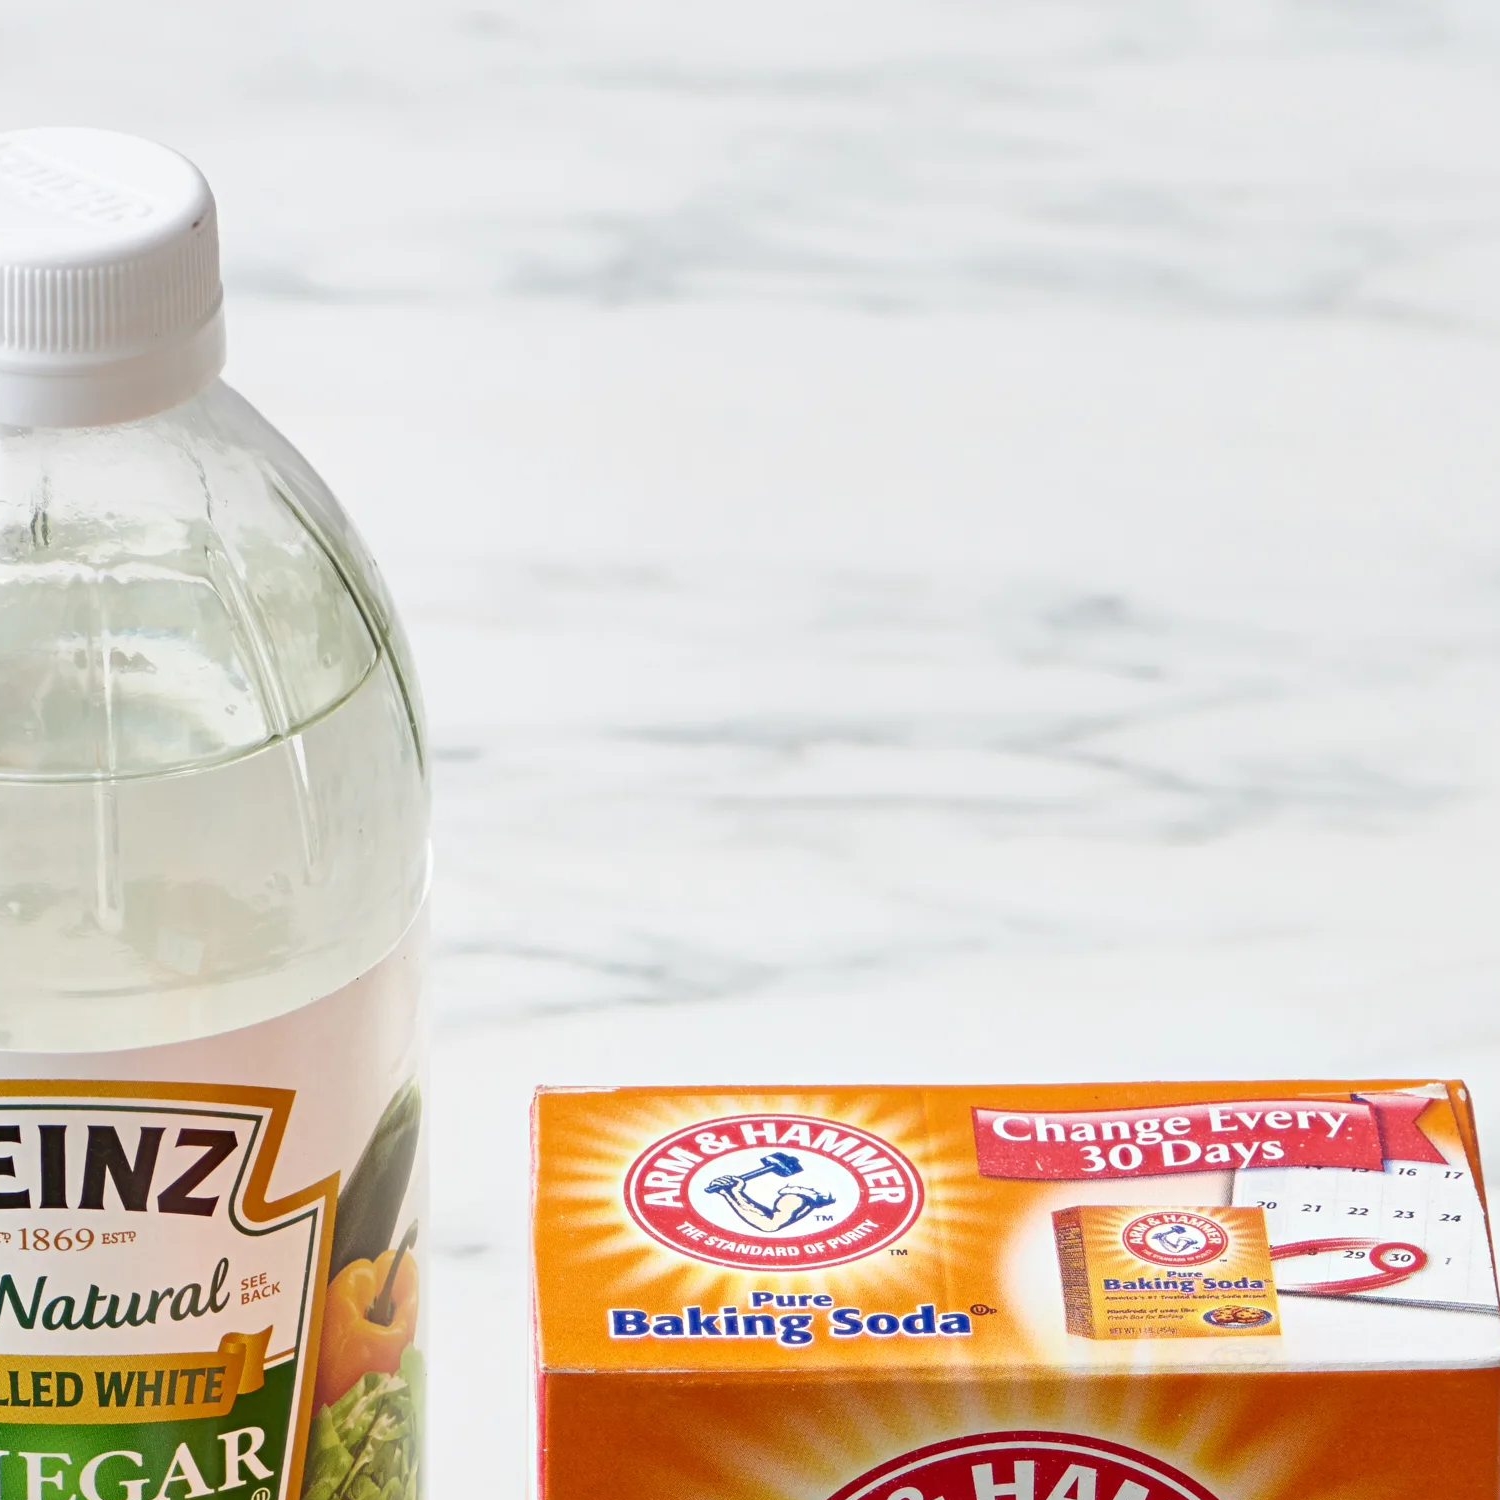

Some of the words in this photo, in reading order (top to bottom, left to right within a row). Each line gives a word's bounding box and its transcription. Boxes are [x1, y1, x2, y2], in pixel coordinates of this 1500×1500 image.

[992, 1115, 1198, 1146] Change
[1210, 1106, 1349, 1137] Every
[644, 1145, 695, 1209] ARM
[694, 1131, 734, 1155] &
[743, 1122, 906, 1205] HAMMER
[1081, 1143, 1141, 1172] 30
[1164, 1137, 1286, 1169] Days
[1398, 1167, 1417, 1177] 16
[1444, 1170, 1464, 1180] 17
[1301, 1204, 1322, 1213] 21
[1347, 1207, 1369, 1216] 22
[1393, 1210, 1415, 1219] 23
[1439, 1213, 1462, 1223] 24
[18, 1228, 95, 1251] 1869
[675, 1220, 706, 1246] THE
[703, 1234, 800, 1257] STANDARD
[804, 1240, 826, 1255] OF
[825, 1218, 879, 1248] PURITY
[1130, 1222, 1149, 1244] ARM
[1147, 1216, 1161, 1226] &
[1163, 1215, 1222, 1244] HAMMER
[1343, 1250, 1366, 1259] 29
[1389, 1253, 1411, 1263] 30
[241, 1272, 267, 1291] SEE
[1104, 1278, 1194, 1292] Baking
[1203, 1277, 1264, 1290] Soda
[1167, 1270, 1203, 1279] Pure
[241, 1281, 280, 1305] BACK
[752, 1291, 833, 1308] Pure
[612, 1306, 813, 1345] Baking
[833, 1306, 971, 1336] Soda
[97, 1366, 224, 1408] WHITE
